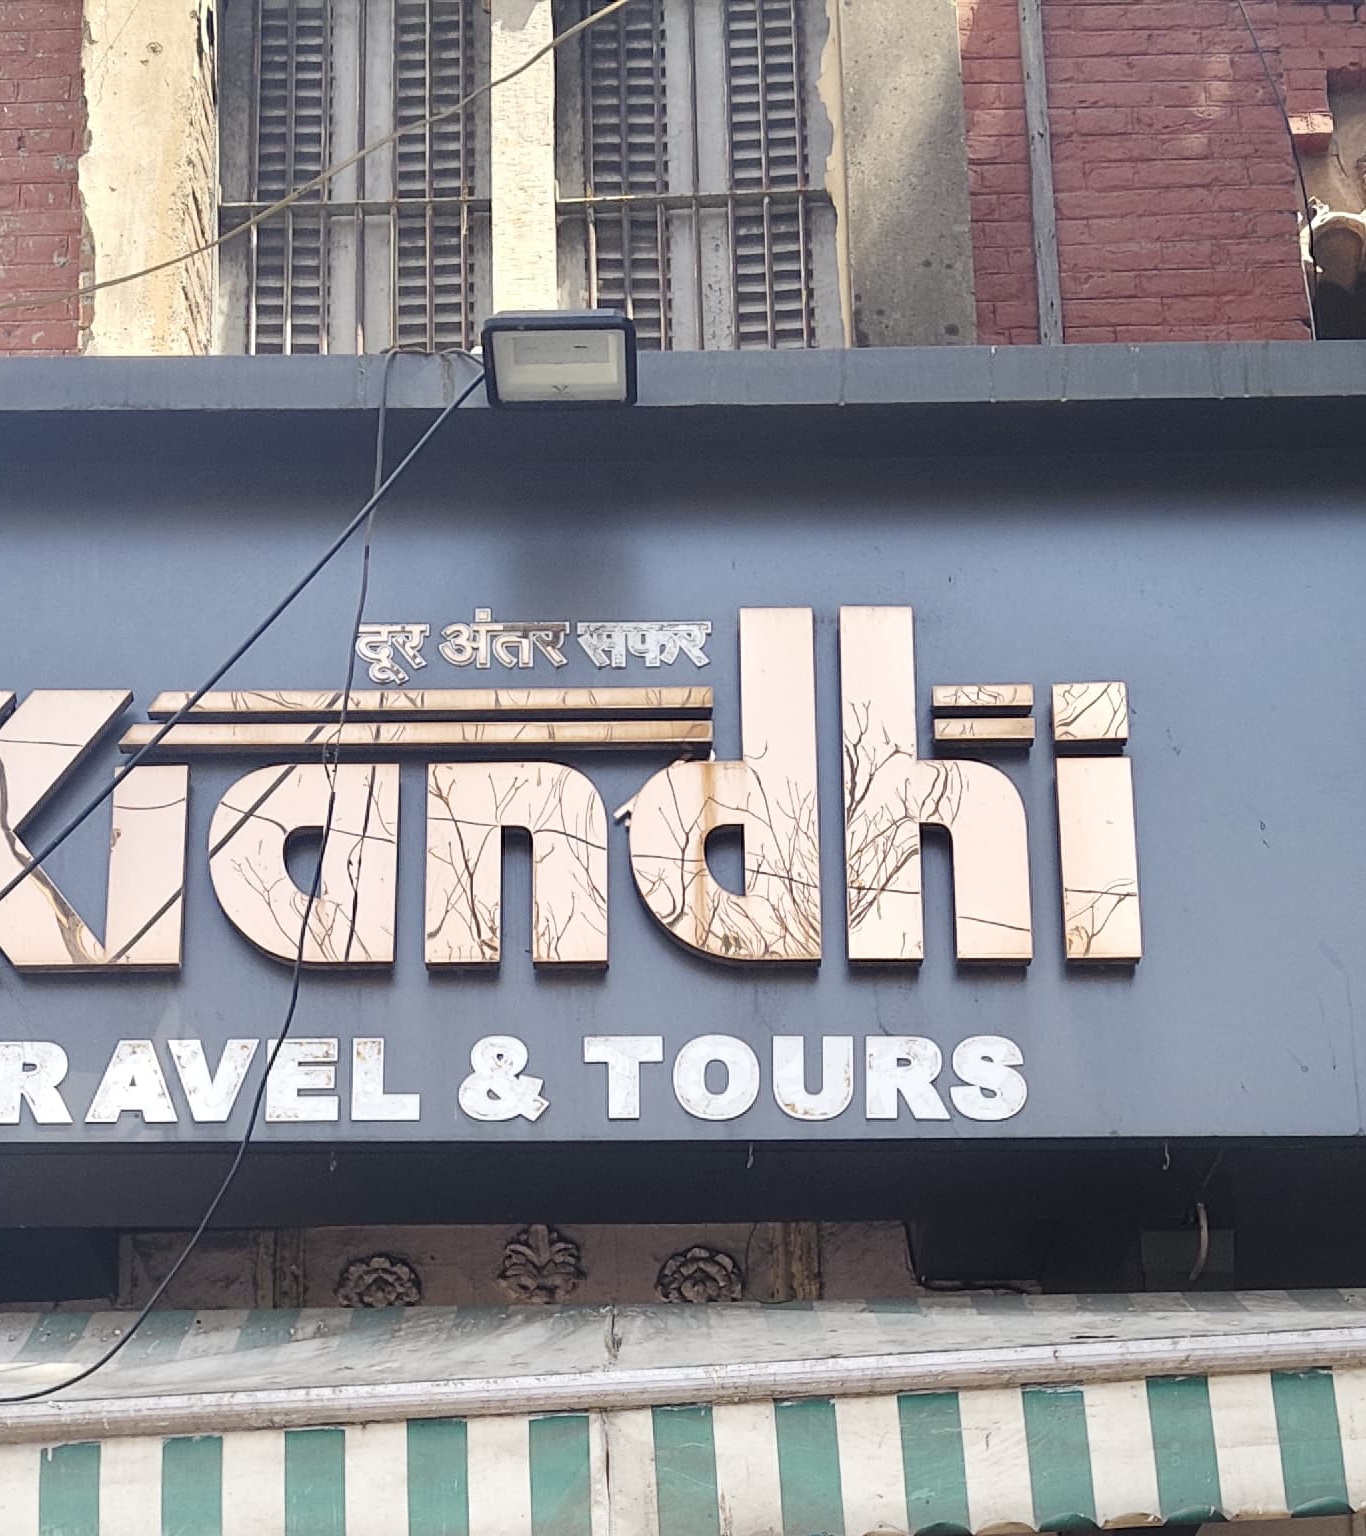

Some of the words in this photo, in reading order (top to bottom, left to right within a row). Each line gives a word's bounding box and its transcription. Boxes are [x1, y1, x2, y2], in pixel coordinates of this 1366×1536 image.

[356, 623, 430, 685] दूर
[439, 608, 570, 669] अंतर
[577, 621, 712, 669] सफर
[459, 1035, 550, 1122] &
[584, 1034, 1029, 1122] TOURS
